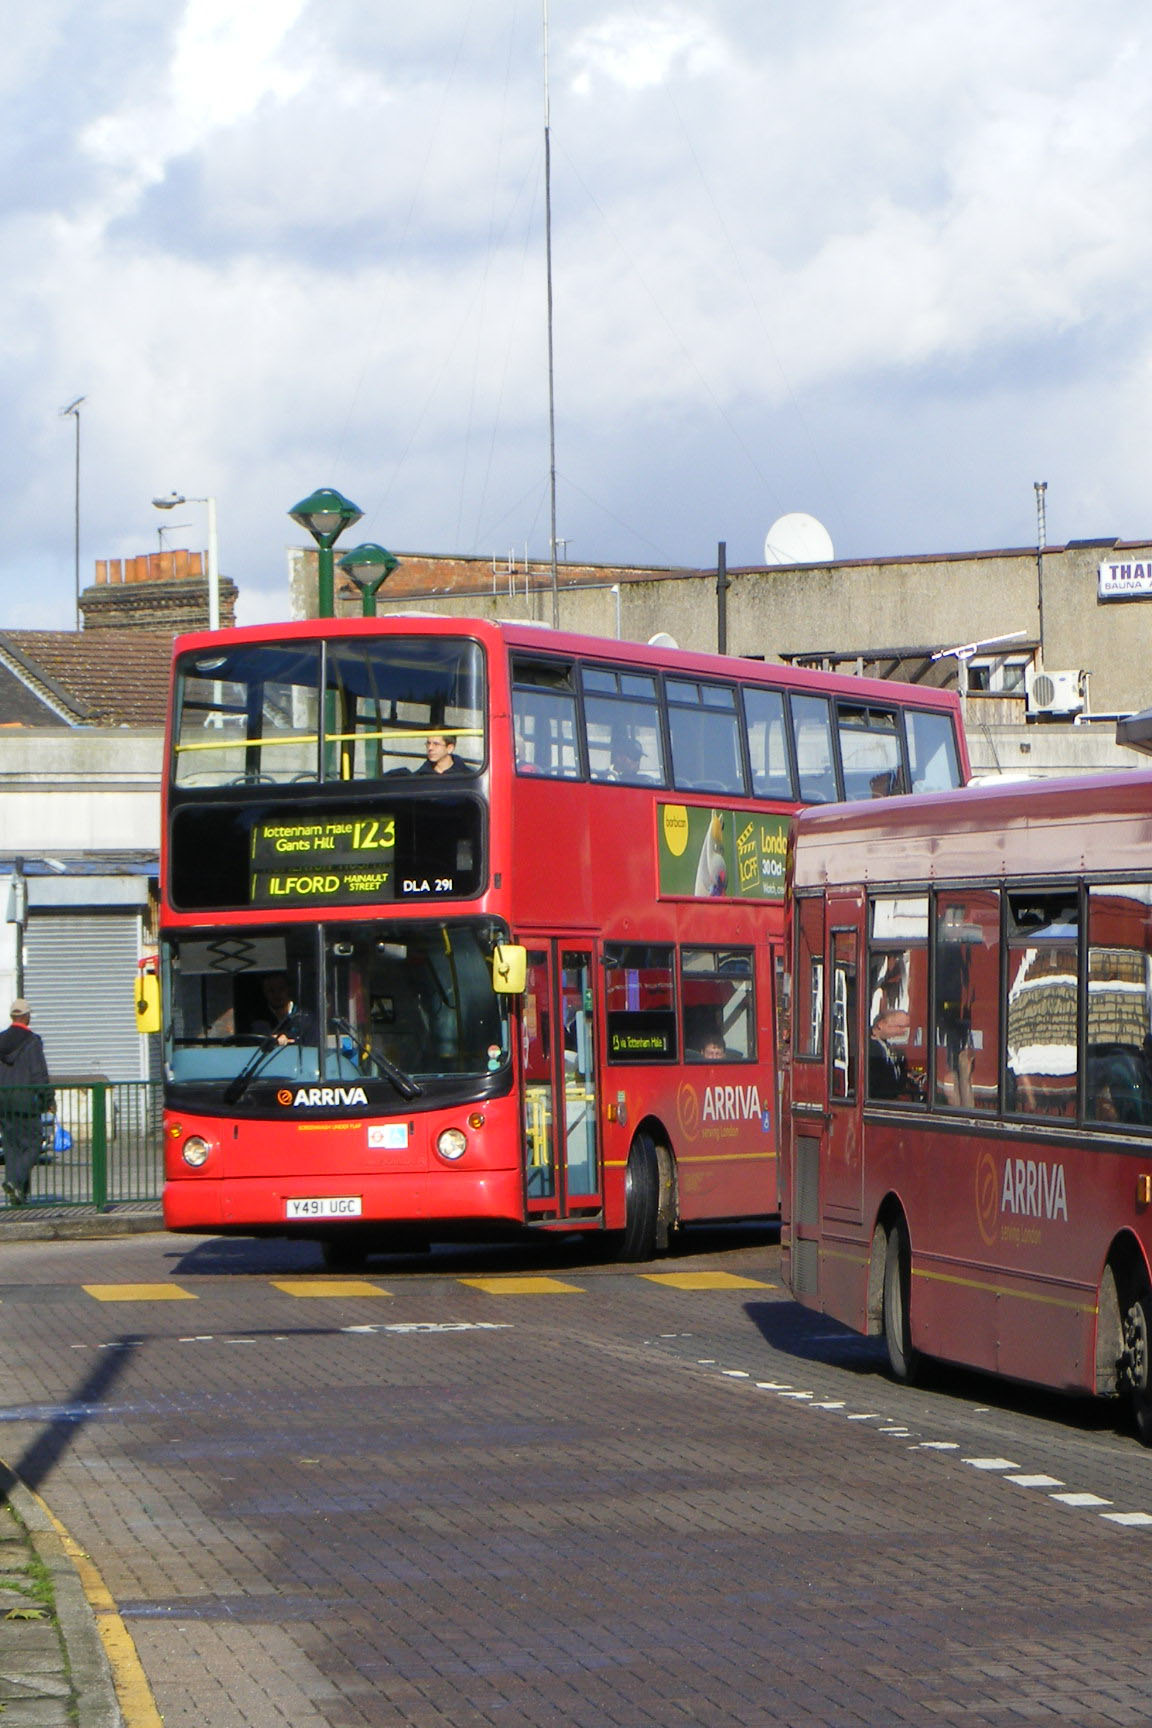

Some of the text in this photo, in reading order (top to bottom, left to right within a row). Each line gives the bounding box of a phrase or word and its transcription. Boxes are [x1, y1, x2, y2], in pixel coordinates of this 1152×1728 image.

[1109, 563, 1152, 580] THAI
[1104, 581, 1142, 590] SAUNA
[353, 820, 395, 849] 123
[276, 837, 334, 851] Gants Hill
[270, 873, 388, 895] ILFORD HAINAULT
[349, 881, 381, 891] STREET
[403, 879, 453, 892] DLA 291
[293, 1087, 368, 1107] ARRIVA
[703, 1085, 762, 1121] ARRIVA
[1001, 1157, 1068, 1222] ARRIVA
[293, 1199, 355, 1215] Y491 UGC
